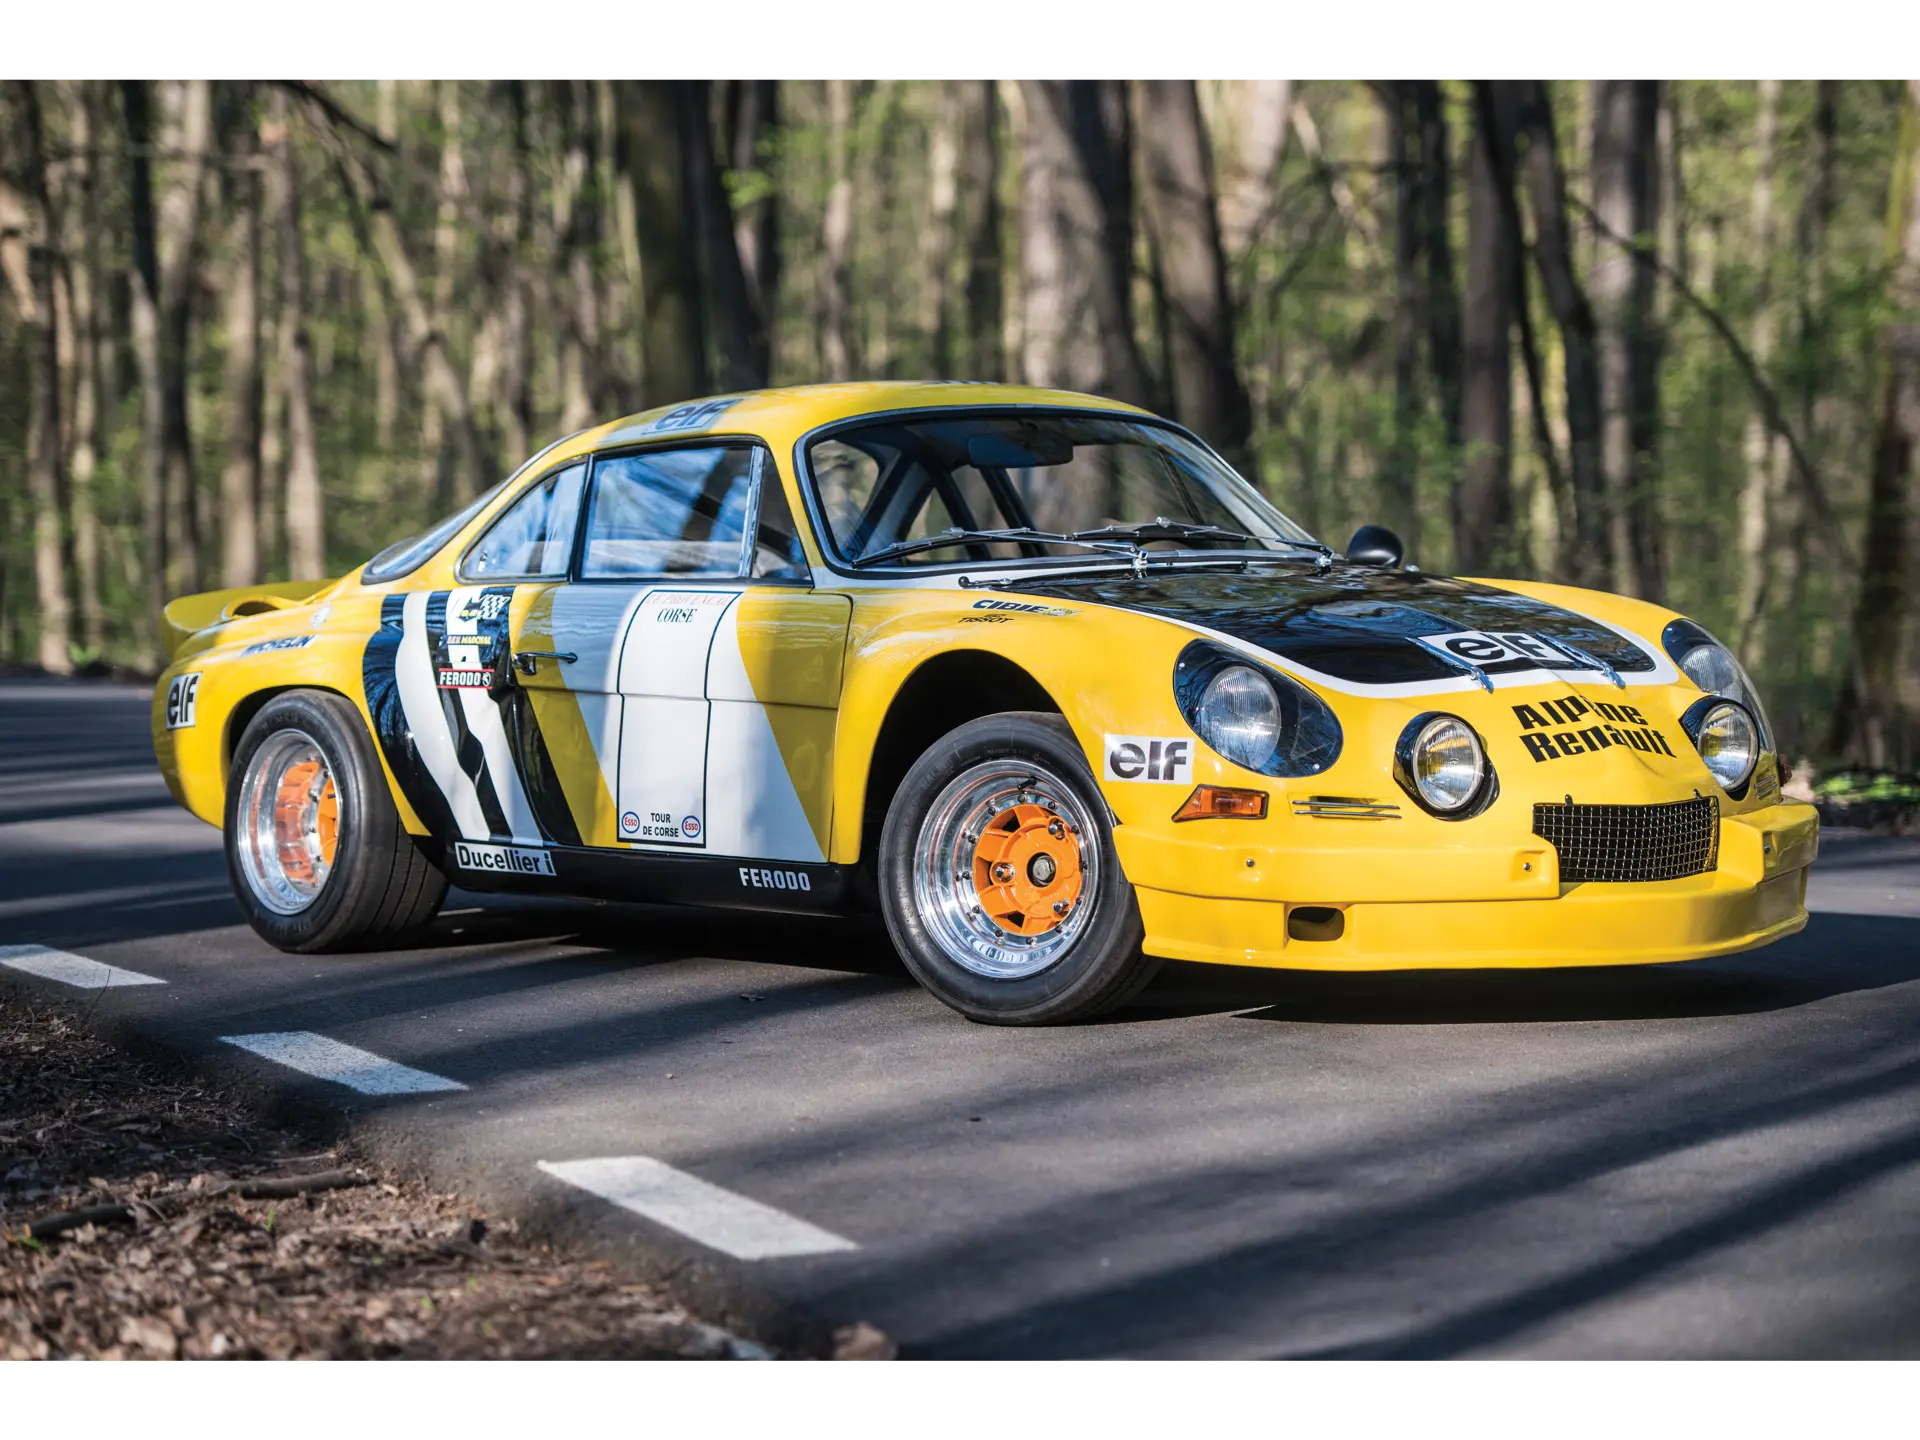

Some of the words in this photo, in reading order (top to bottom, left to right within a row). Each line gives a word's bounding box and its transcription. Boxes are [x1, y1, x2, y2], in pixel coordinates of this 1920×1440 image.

[655, 398, 743, 430] elf
[657, 608, 698, 623] CORSE
[1446, 632, 1548, 660] elf
[440, 671, 481, 686] FERODO
[168, 675, 199, 726] elf
[1519, 724, 1677, 763] Renault
[1110, 741, 1188, 780] elf
[643, 826, 652, 836] DE
[654, 827, 679, 838] CORSE
[651, 812, 671, 824] TOUR
[458, 845, 540, 873] Ducellier
[739, 867, 811, 891] FERODO
